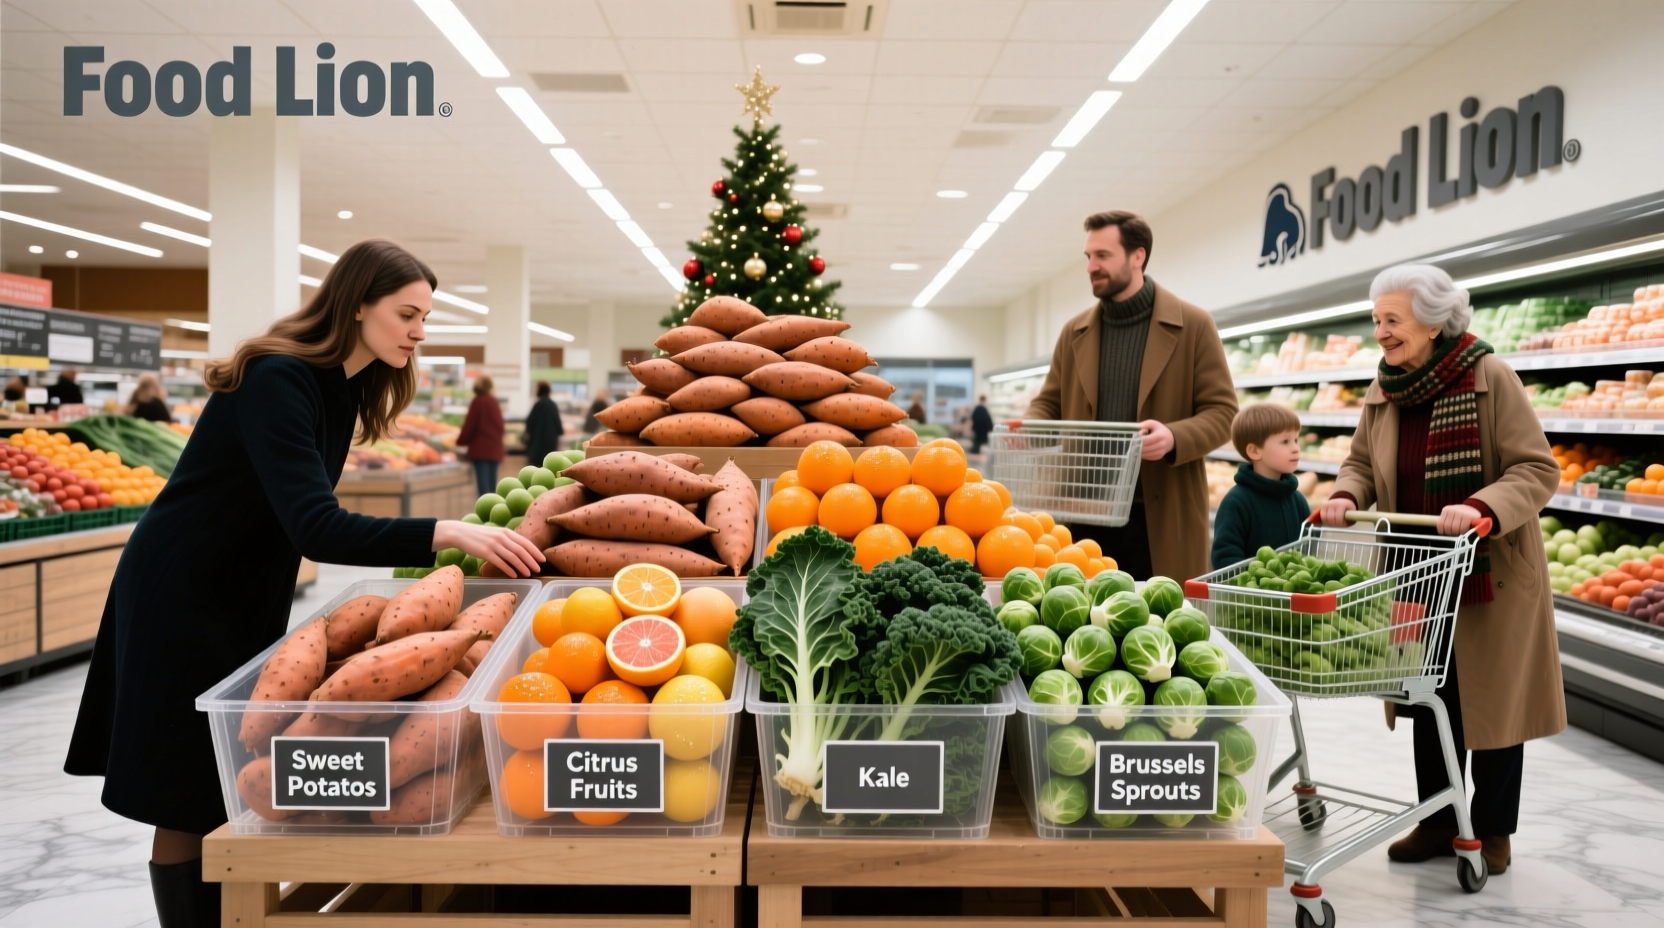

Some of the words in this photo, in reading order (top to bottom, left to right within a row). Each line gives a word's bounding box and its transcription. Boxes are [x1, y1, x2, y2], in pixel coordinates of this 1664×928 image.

[1309, 126, 1419, 249] Food
[291, 749, 364, 771] Sweet
[566, 751, 638, 773] Citrus
[1109, 752, 1206, 775] Brussels
[288, 775, 377, 797] Potatos
[859, 765, 910, 788] Kale
[570, 778, 638, 800] Fruits
[1111, 779, 1201, 806] Sprouts
